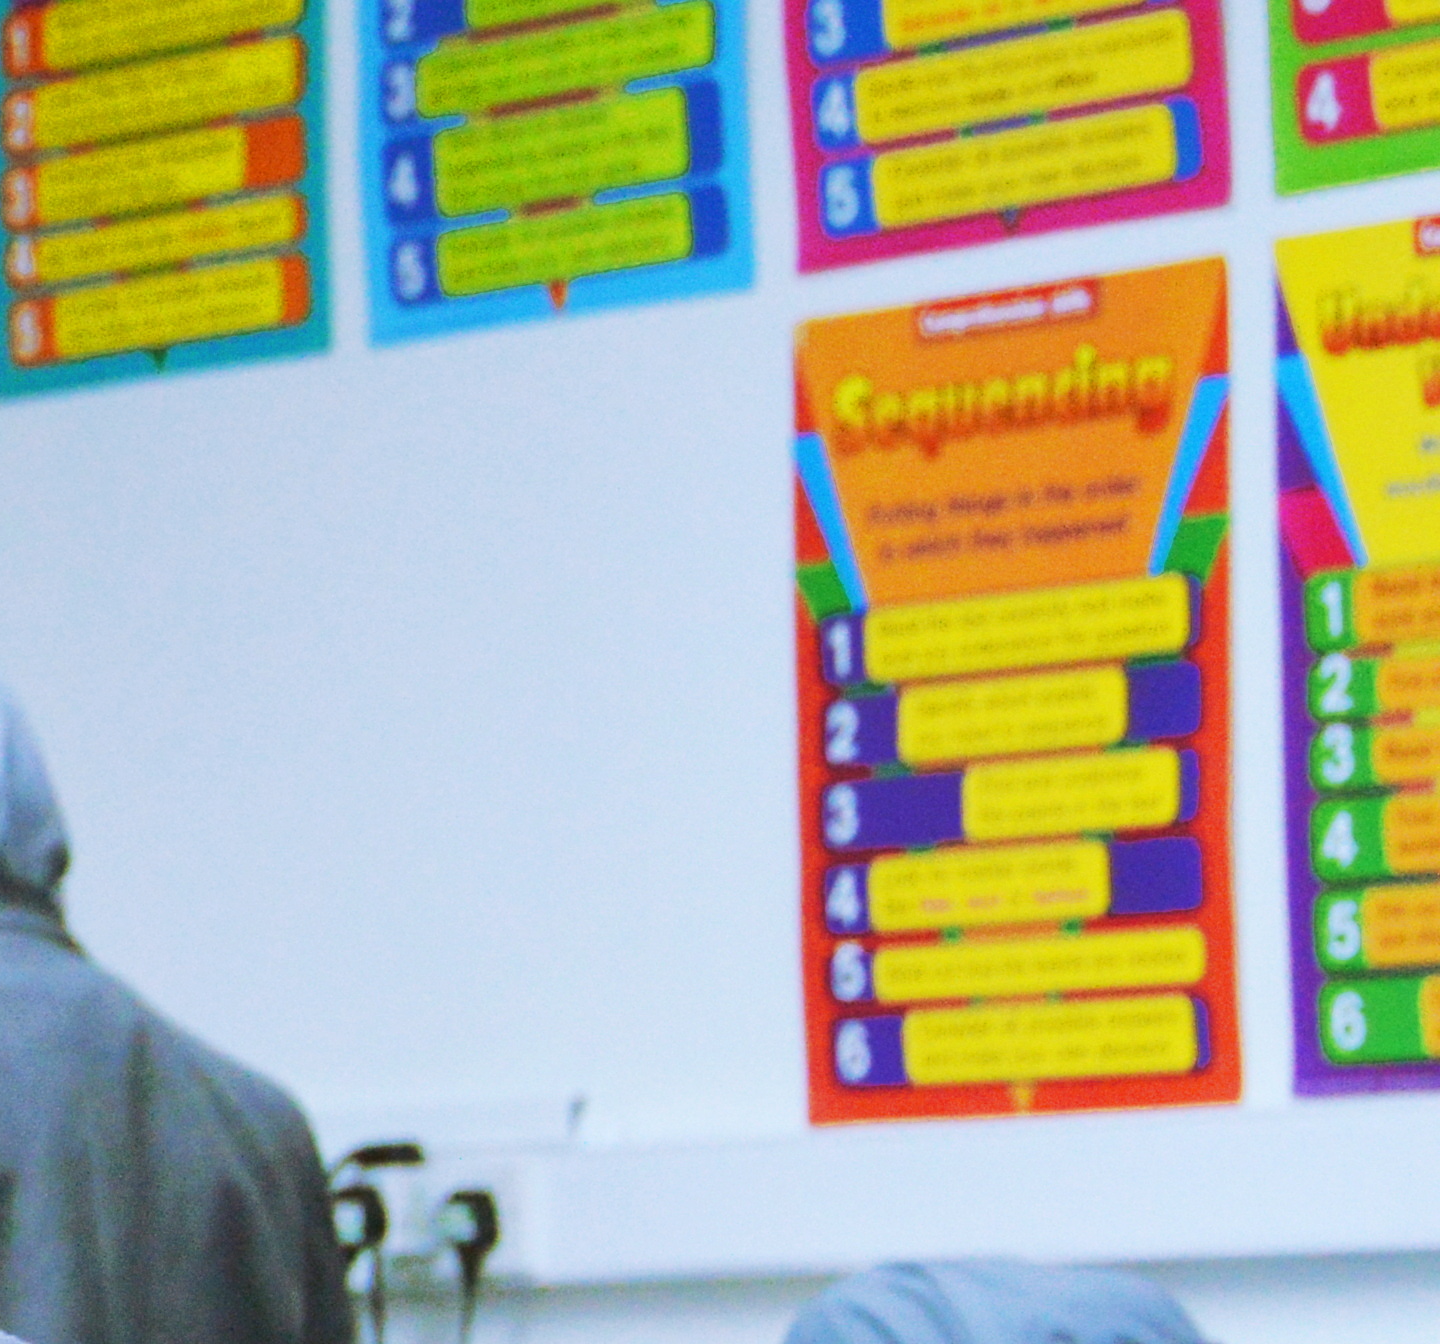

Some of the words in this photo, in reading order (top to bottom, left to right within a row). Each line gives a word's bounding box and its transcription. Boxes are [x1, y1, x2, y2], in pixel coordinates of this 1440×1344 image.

[813, 0, 846, 56] 3
[386, 62, 416, 120] 3
[818, 79, 851, 137] 4
[1305, 70, 1343, 132] 4
[388, 150, 418, 205] 4
[825, 165, 860, 228] 5
[393, 242, 426, 300] 5
[830, 338, 1176, 460] Sequencing
[1320, 581, 1344, 638] 1
[829, 619, 851, 678] 1
[1320, 653, 1353, 711] 2
[827, 701, 860, 762] 2
[1321, 723, 1355, 782] 3
[827, 784, 860, 846] 3
[1323, 810, 1359, 867] 4
[828, 867, 860, 925] 4
[1327, 901, 1361, 959] 5
[831, 942, 867, 1000] 5
[1331, 992, 1367, 1050] 6
[835, 1021, 872, 1081] 6
